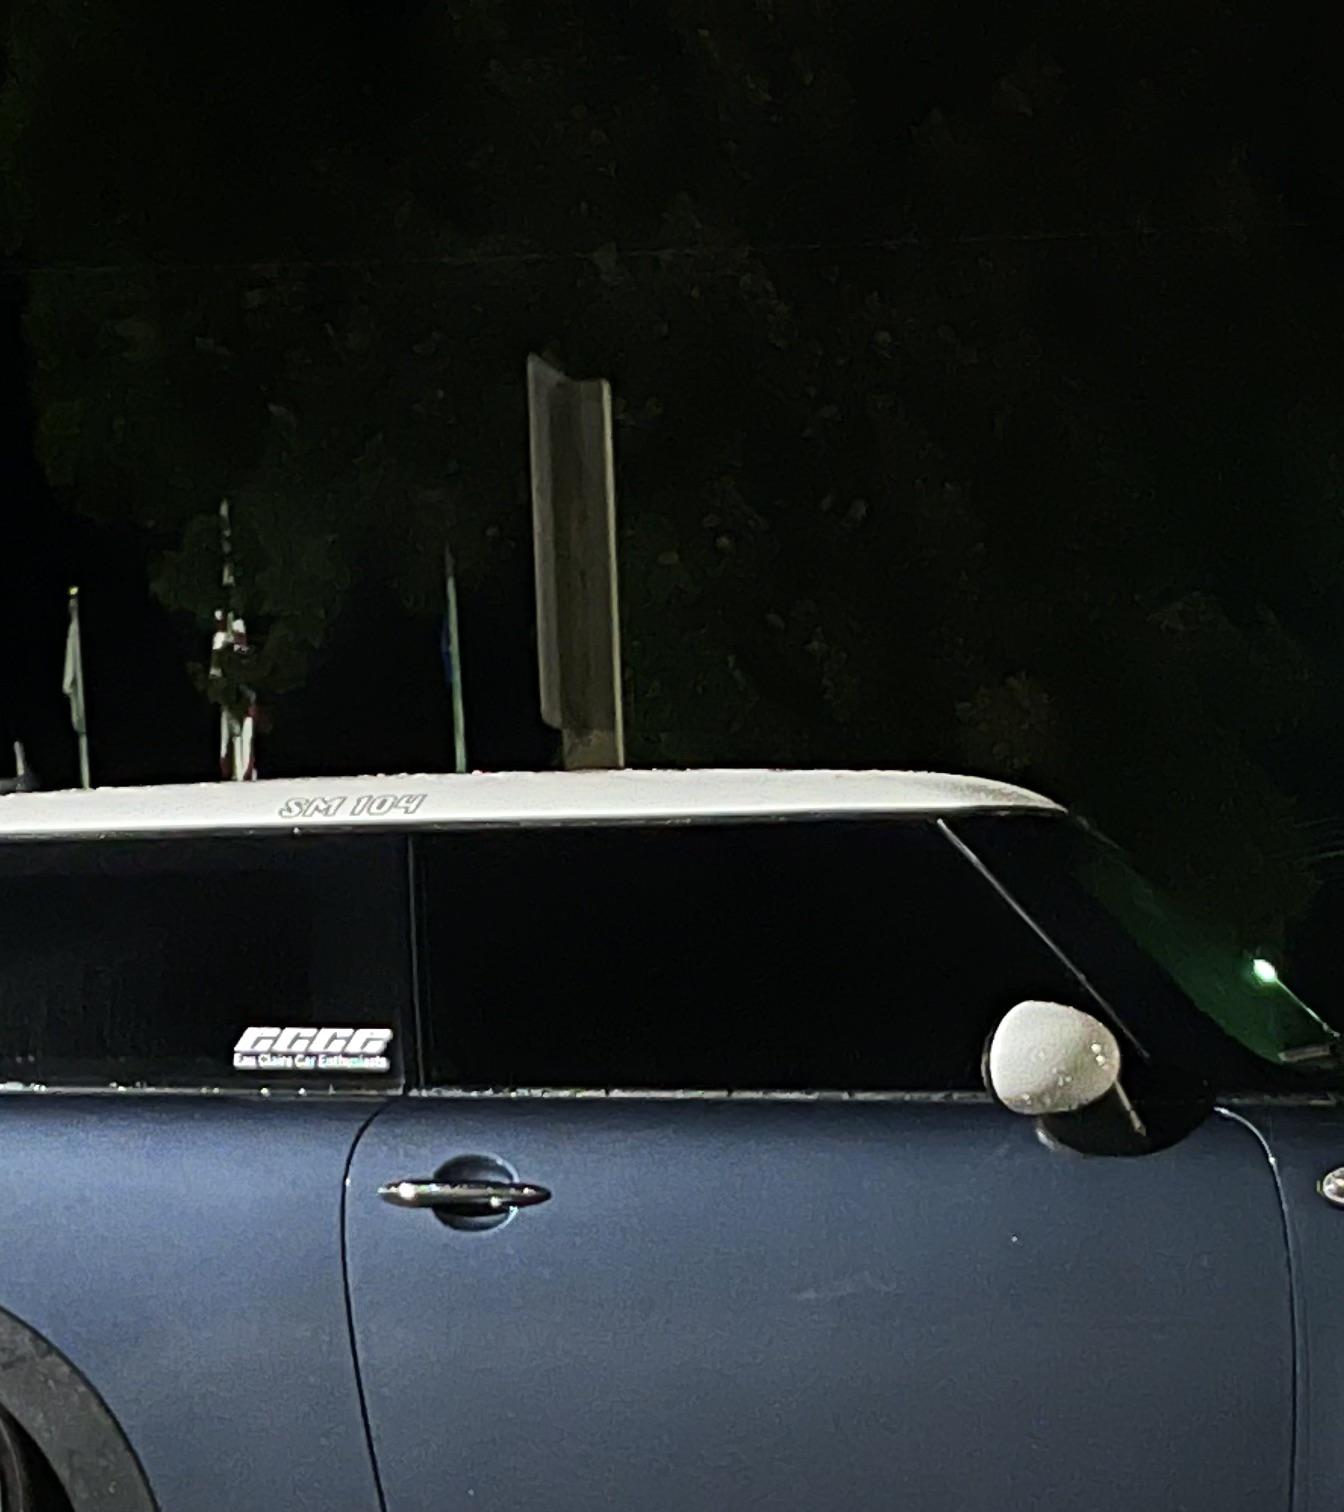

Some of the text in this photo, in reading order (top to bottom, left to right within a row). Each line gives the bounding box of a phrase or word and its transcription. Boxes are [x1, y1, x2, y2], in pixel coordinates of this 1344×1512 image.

[278, 794, 428, 818] SM 104
[233, 1053, 389, 1071] Eau Claire Car Enthusiasts
